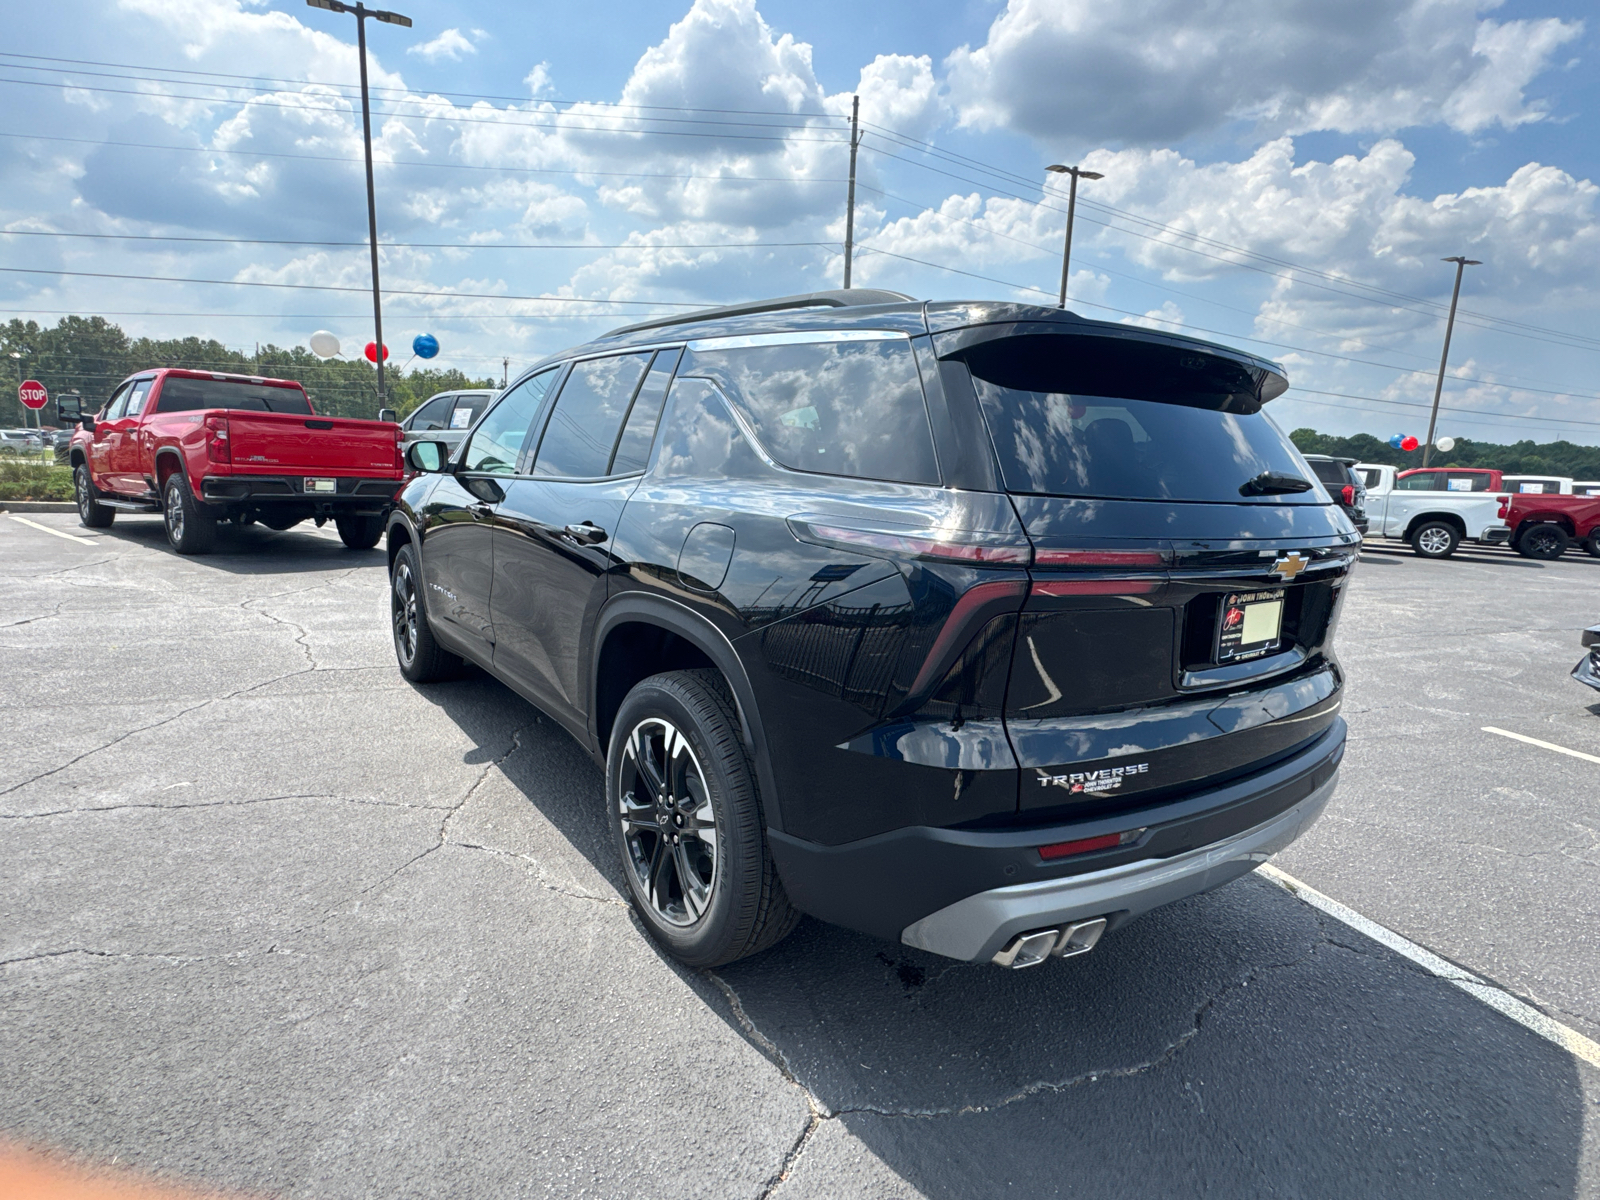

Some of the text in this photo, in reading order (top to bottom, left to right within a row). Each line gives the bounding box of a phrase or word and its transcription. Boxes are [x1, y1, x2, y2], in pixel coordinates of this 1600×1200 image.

[20, 389, 45, 400] STOP
[1240, 590, 1284, 602] JOHN THORNON
[1037, 763, 1149, 787] TRAVERSE
[1083, 784, 1113, 793] CHEVROLET
